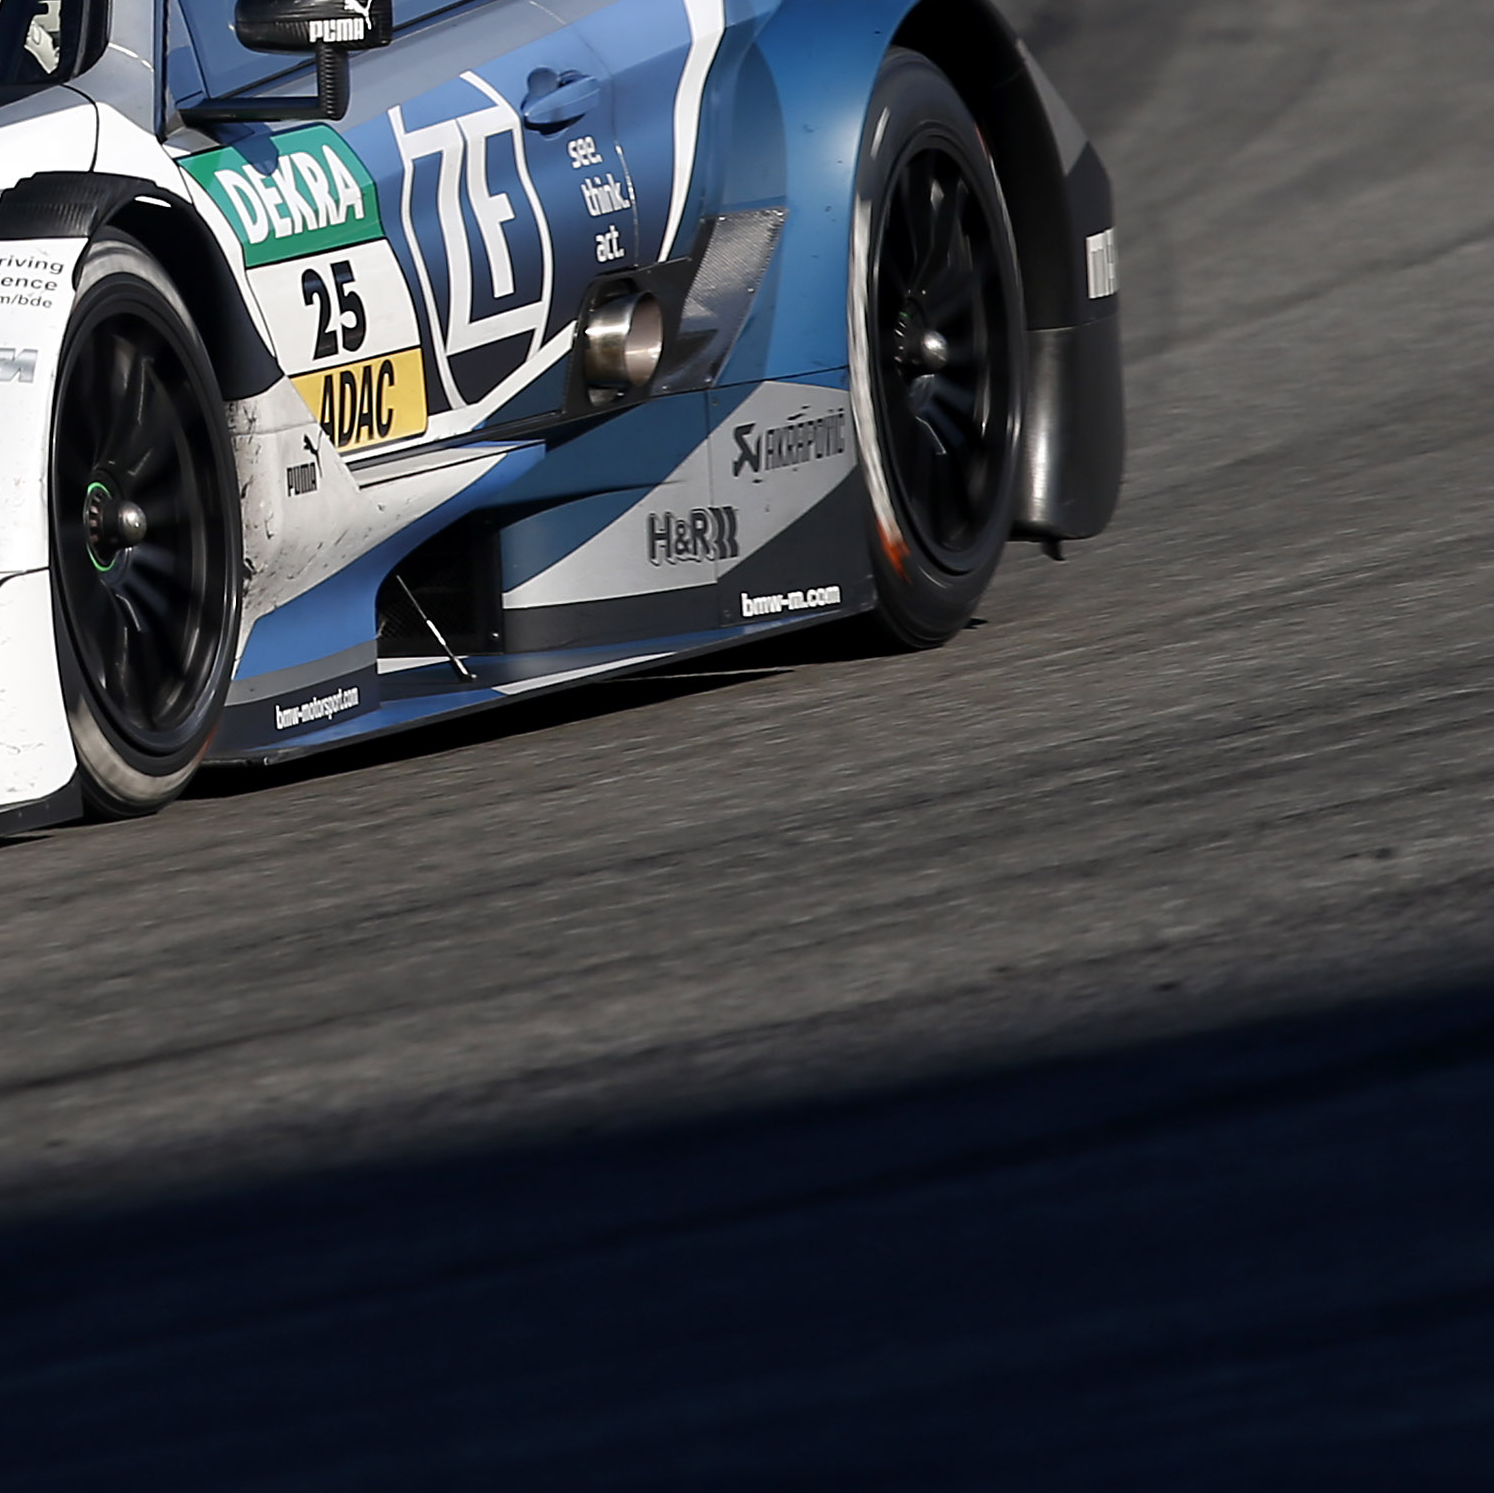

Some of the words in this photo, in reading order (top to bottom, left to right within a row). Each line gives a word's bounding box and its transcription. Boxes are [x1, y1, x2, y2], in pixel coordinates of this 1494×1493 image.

[214, 144, 365, 244] DEKRA
[402, 104, 547, 357] ZF
[300, 259, 367, 362] 25
[319, 358, 396, 448] ADAC
[648, 507, 713, 566] H&R
[740, 585, 842, 618] bmw-m.com
